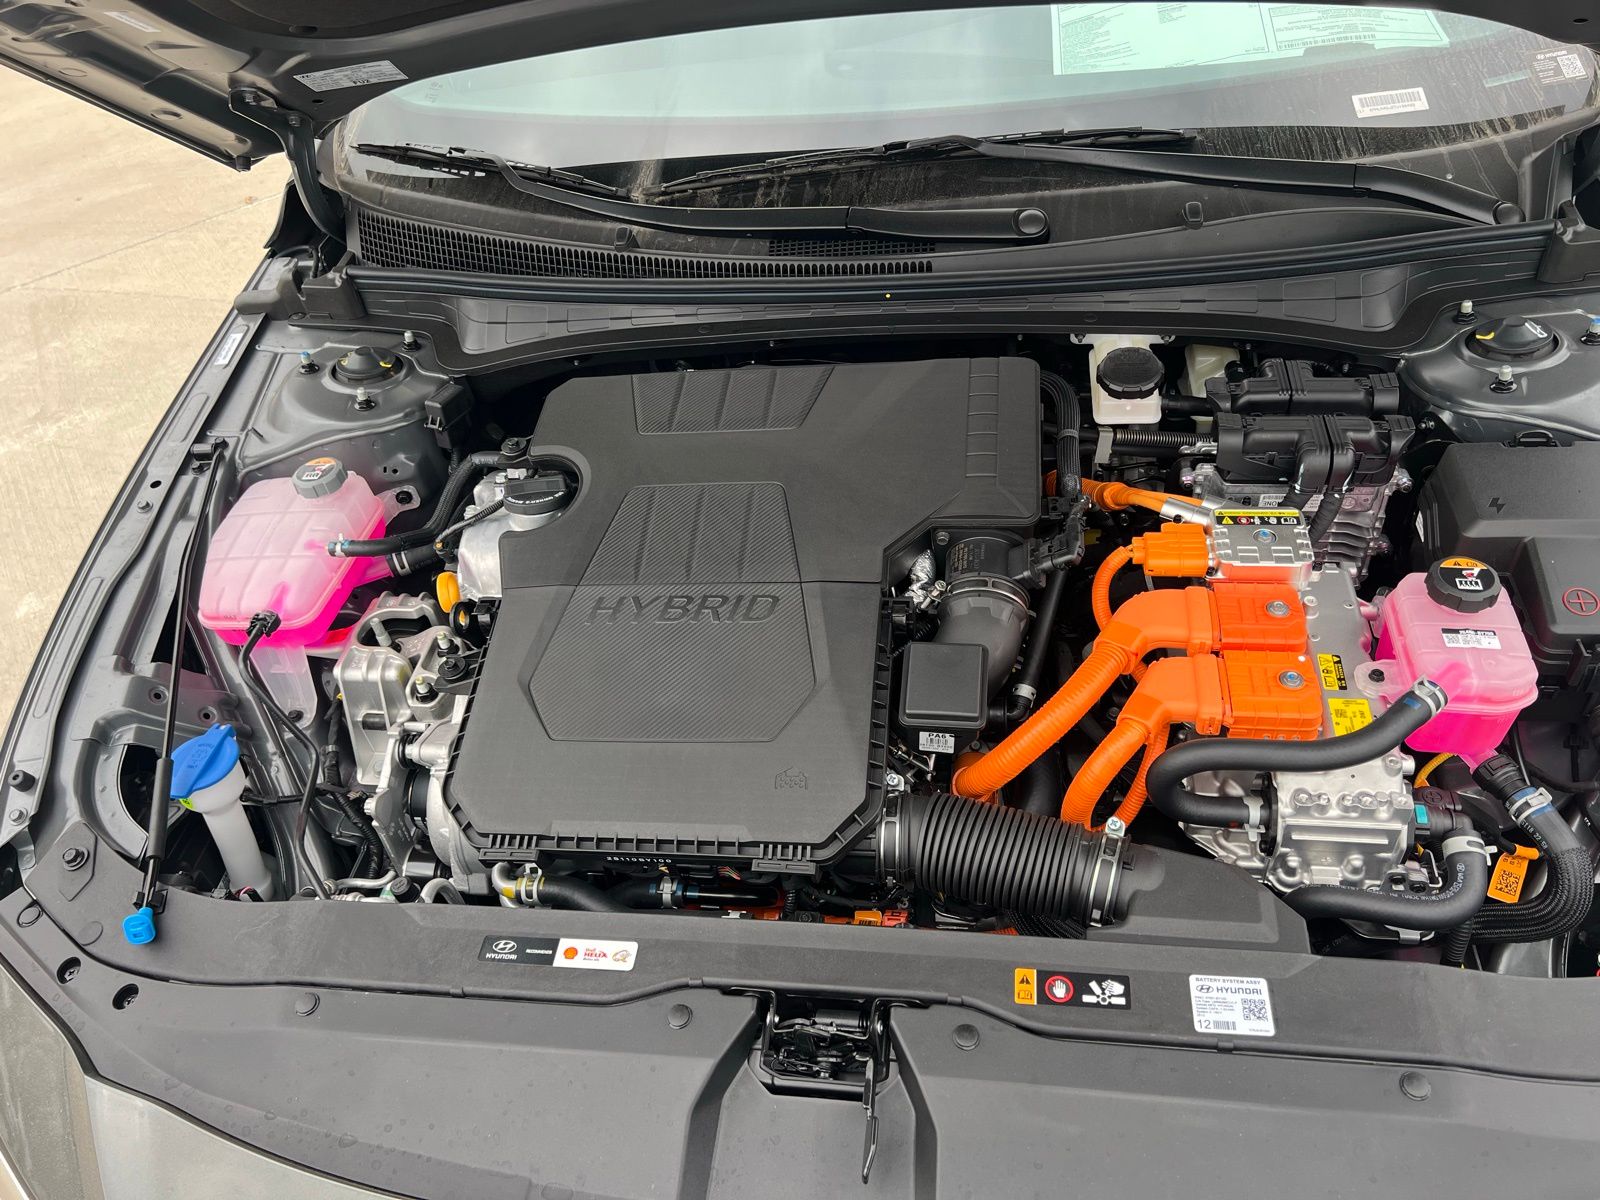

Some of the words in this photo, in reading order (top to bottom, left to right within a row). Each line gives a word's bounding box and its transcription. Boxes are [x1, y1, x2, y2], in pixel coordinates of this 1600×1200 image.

[586, 594, 780, 625] HYBRID
[485, 953, 518, 961] HYUNDAI
[1216, 986, 1262, 995] HYUNDAI
[1197, 1019, 1211, 1030] 12
